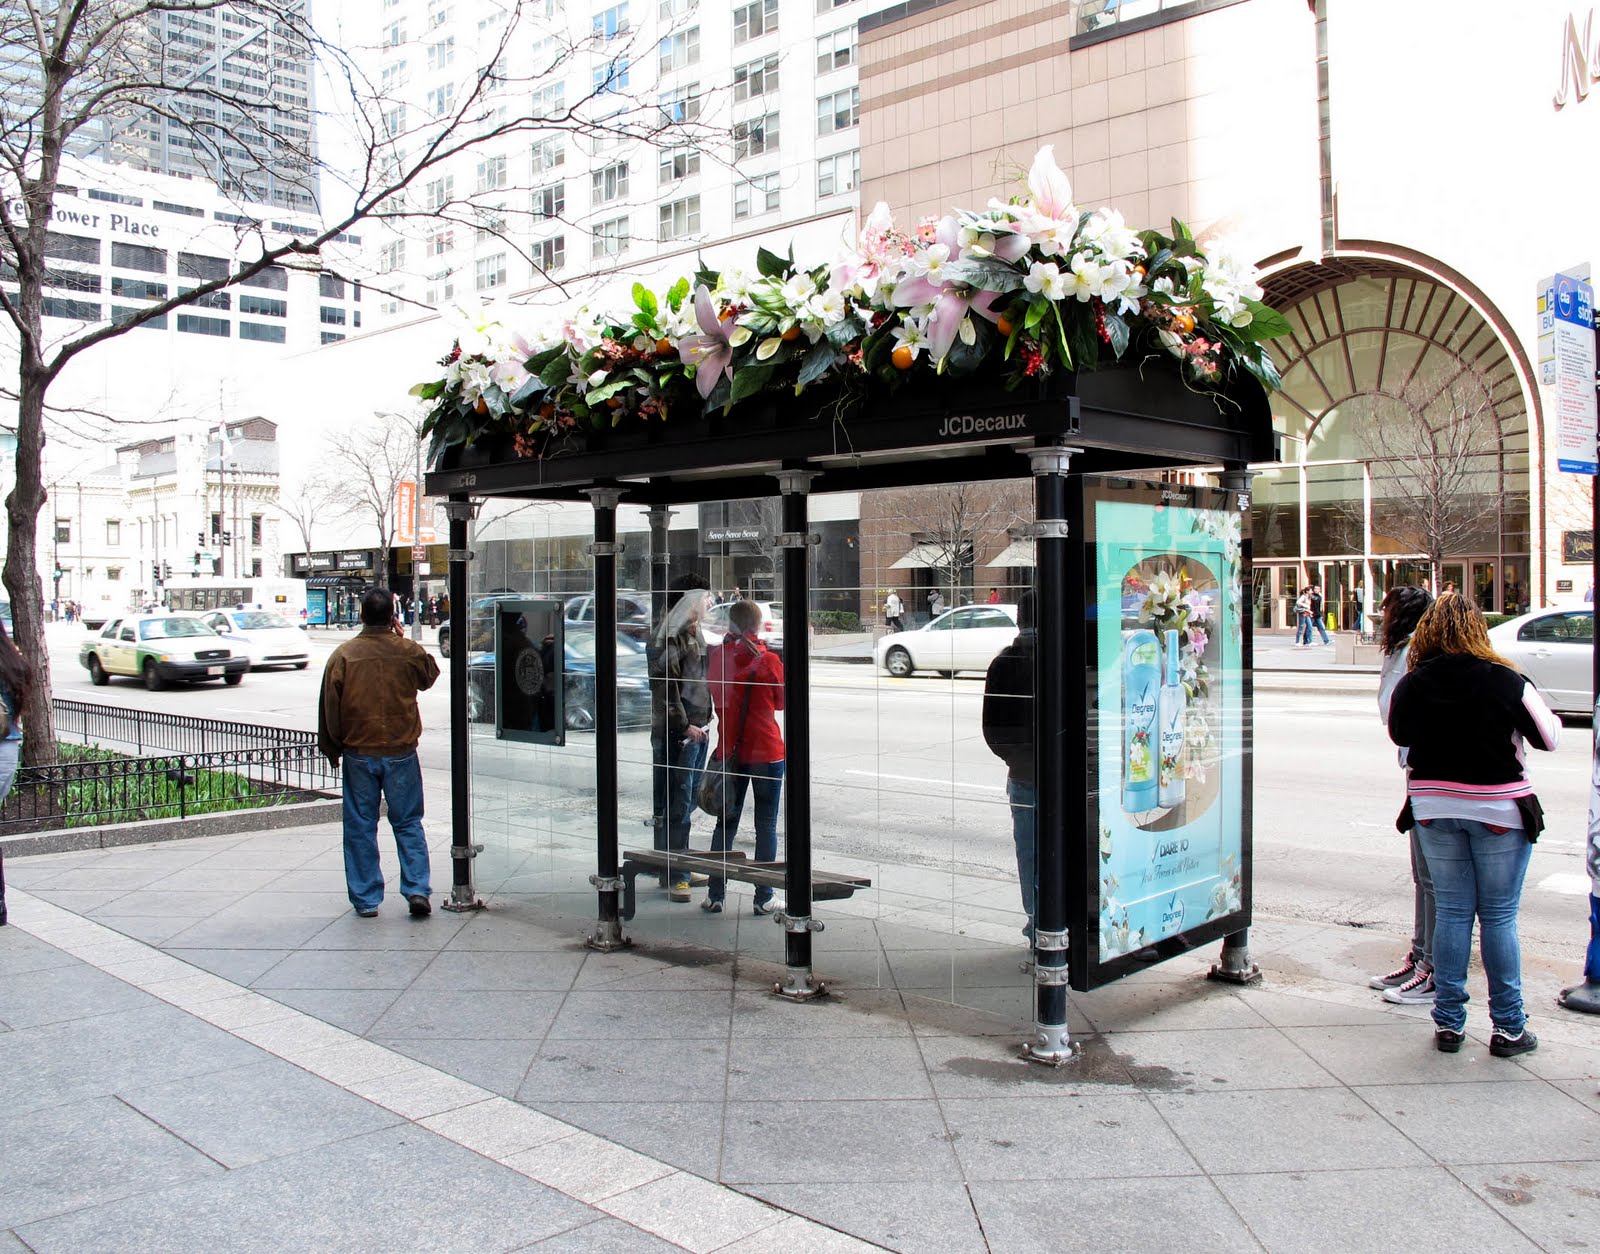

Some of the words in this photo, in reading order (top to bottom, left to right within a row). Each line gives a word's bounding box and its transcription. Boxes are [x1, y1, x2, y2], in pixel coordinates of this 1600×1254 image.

[50, 205, 100, 228] ower
[110, 214, 159, 236] Place
[1577, 284, 1591, 308] bus
[1543, 315, 1554, 329] BU
[1577, 304, 1593, 327] stop
[939, 414, 1026, 436] JCDecaux
[457, 472, 476, 488] cta
[1161, 490, 1187, 500] JCDecaux
[1132, 704, 1154, 716] Degree
[1162, 732, 1182, 744] Degree
[1160, 842, 1178, 857] DARE
[1162, 910, 1182, 923] Degree
